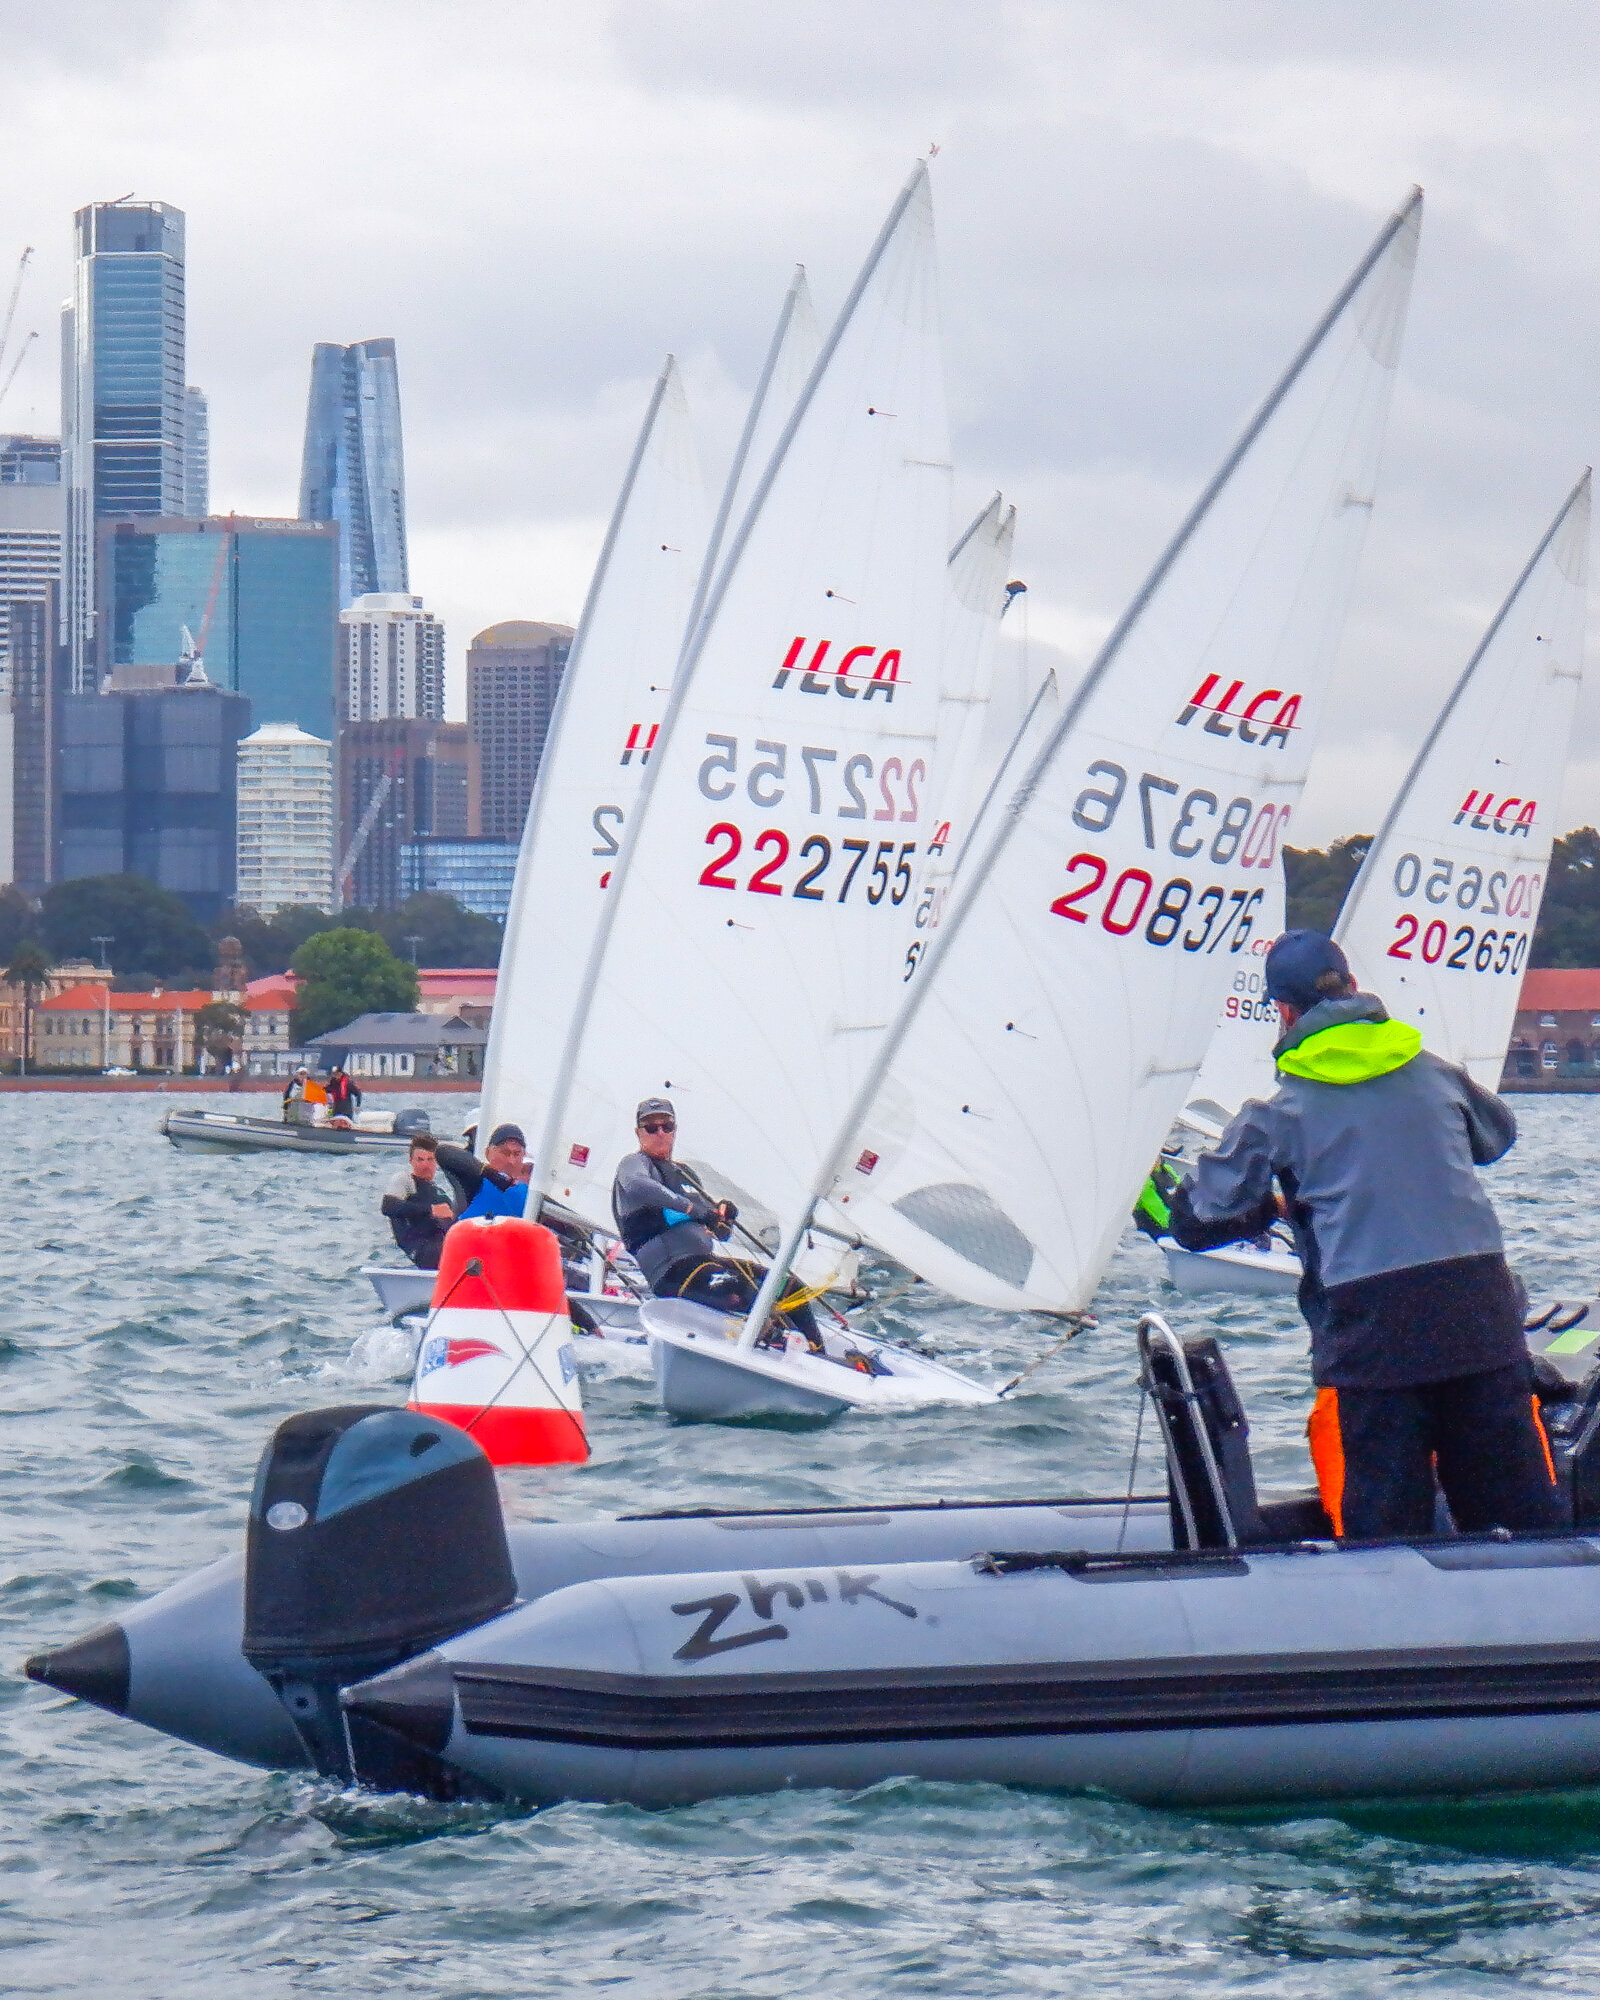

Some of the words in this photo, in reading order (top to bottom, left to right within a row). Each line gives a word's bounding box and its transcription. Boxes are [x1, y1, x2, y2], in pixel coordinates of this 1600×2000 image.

[772, 636, 906, 702] ILCA
[1175, 673, 1302, 749] ILCA
[1453, 789, 1538, 837] ILCA
[698, 822, 916, 905] 222755
[1050, 852, 1264, 954] 208376
[1387, 913, 1527, 975] 202650
